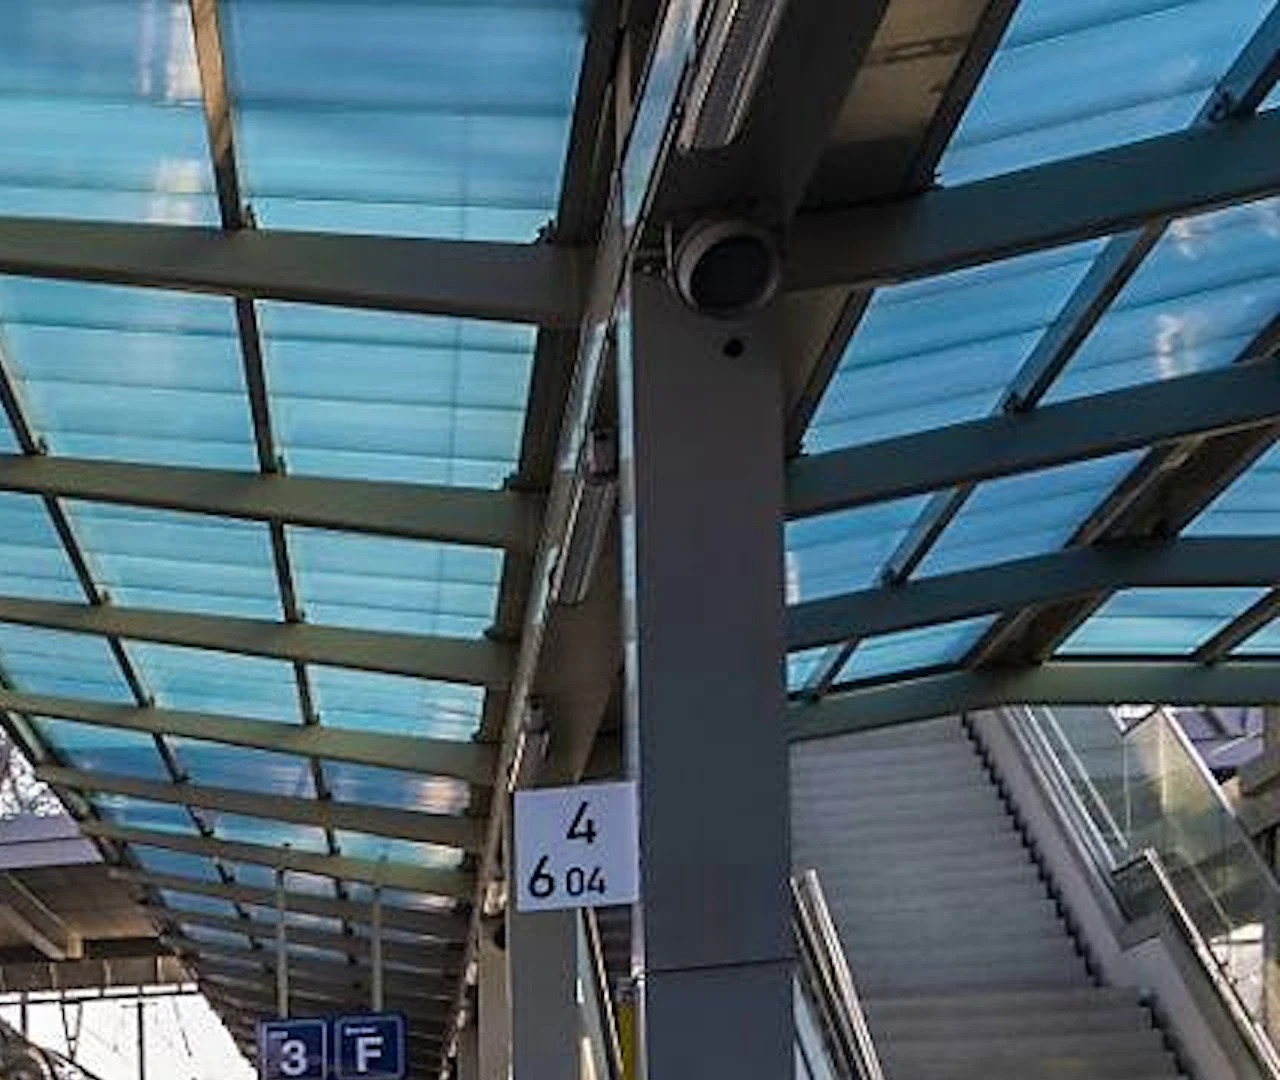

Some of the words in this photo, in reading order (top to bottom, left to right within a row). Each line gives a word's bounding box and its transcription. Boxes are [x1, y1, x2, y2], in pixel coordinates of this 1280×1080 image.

[566, 801, 597, 844] 4
[528, 854, 556, 899] 6
[566, 866, 606, 897] 04
[279, 1039, 308, 1077] 3
[356, 1035, 384, 1073] F
